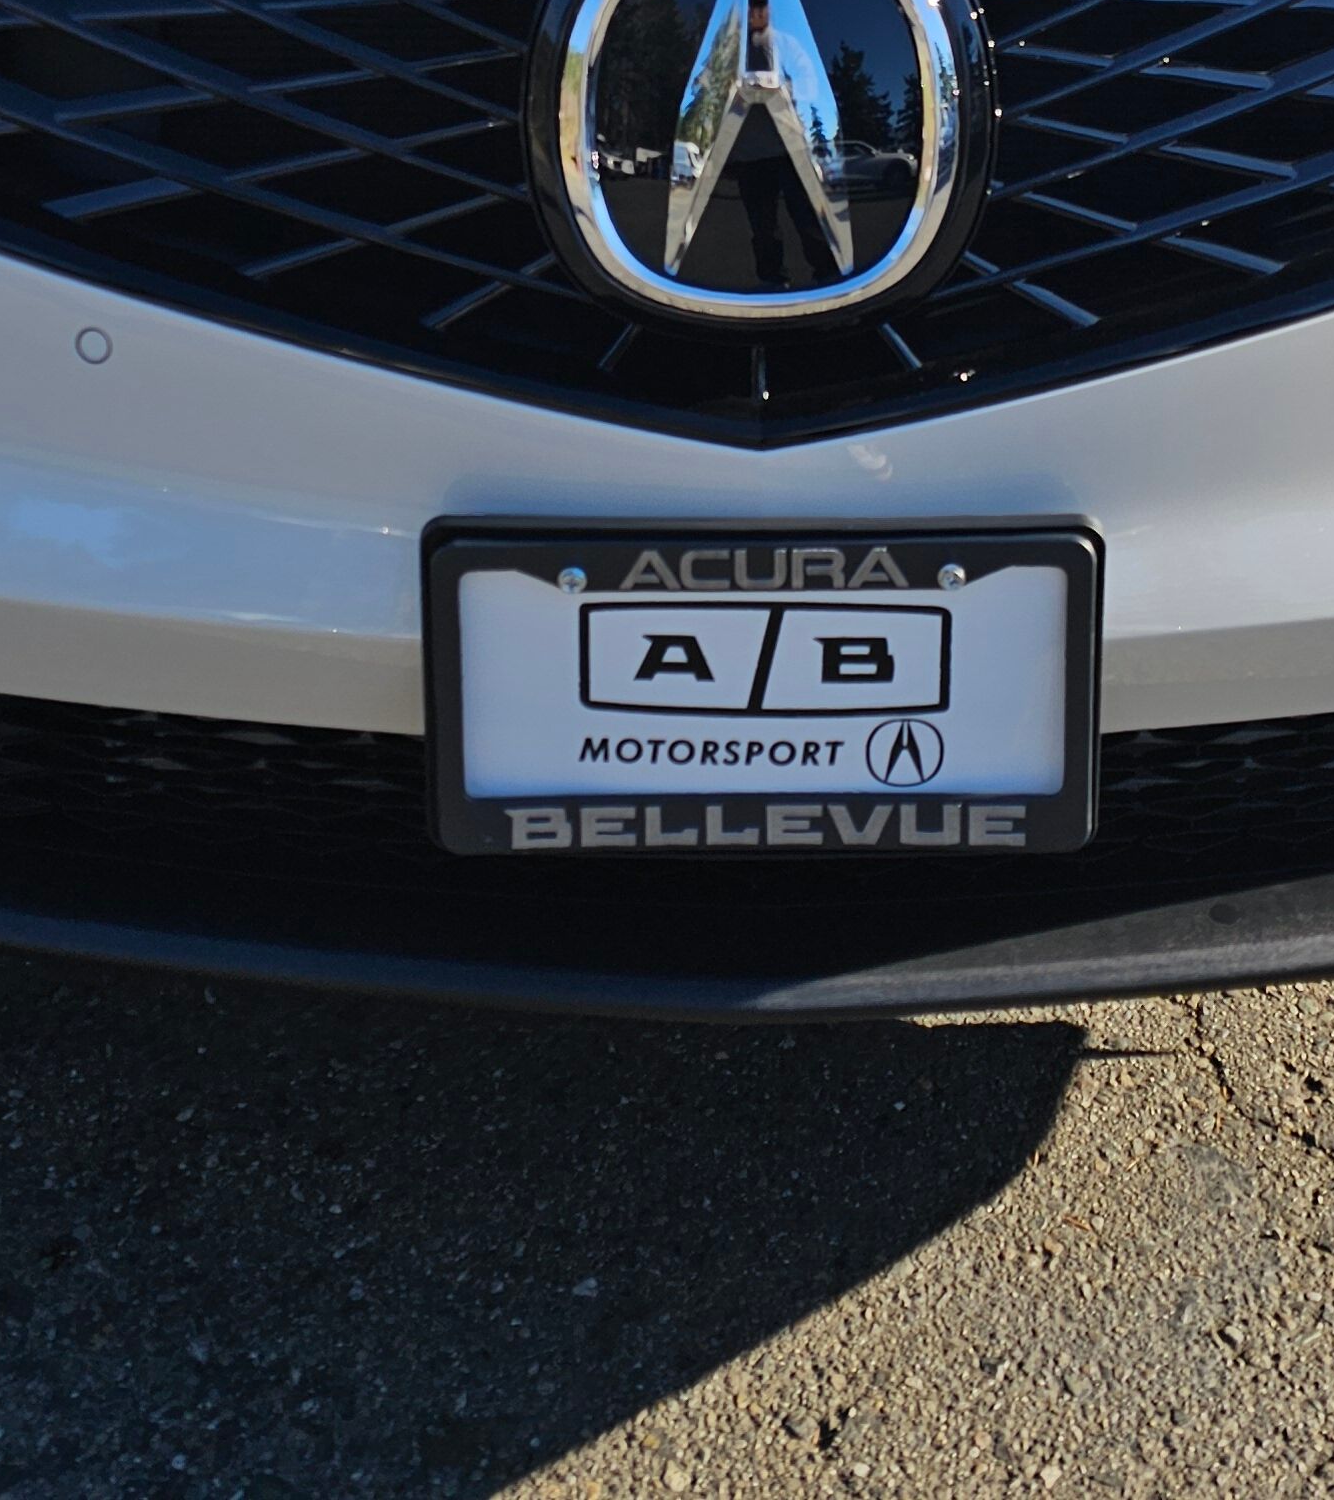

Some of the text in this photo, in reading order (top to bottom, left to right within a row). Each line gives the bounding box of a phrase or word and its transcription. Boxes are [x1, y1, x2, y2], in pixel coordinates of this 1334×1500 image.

[620, 547, 909, 591] ACURA
[578, 737, 845, 767] MOTORSPORT
[504, 804, 1028, 850] BELLEVUE
